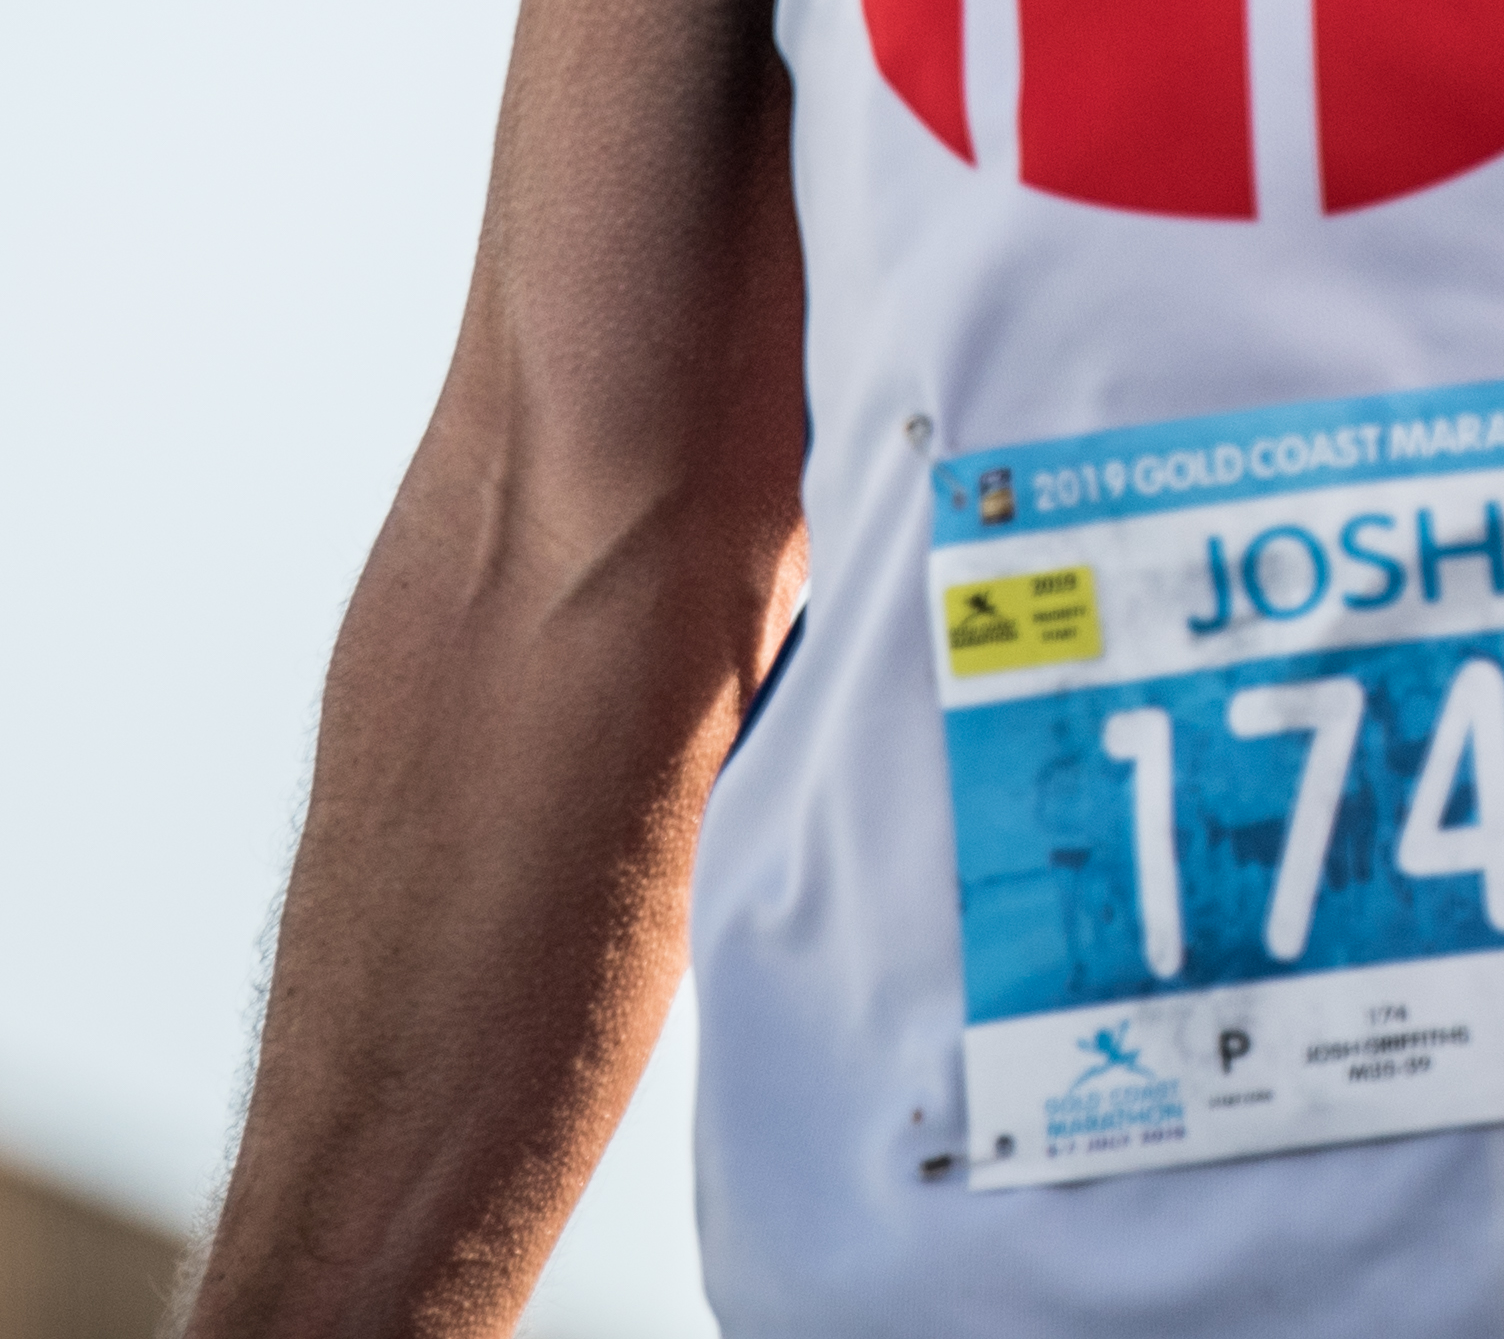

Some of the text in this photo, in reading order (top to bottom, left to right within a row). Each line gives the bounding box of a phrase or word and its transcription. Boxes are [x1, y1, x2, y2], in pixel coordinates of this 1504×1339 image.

[1033, 460, 1125, 513] 2019
[1132, 442, 1243, 497] GOLD
[1250, 424, 1381, 476] COAST
[1366, 1003, 1408, 1025] 174
[1218, 1027, 1251, 1074] P
[1306, 1041, 1361, 1064] JOSH
